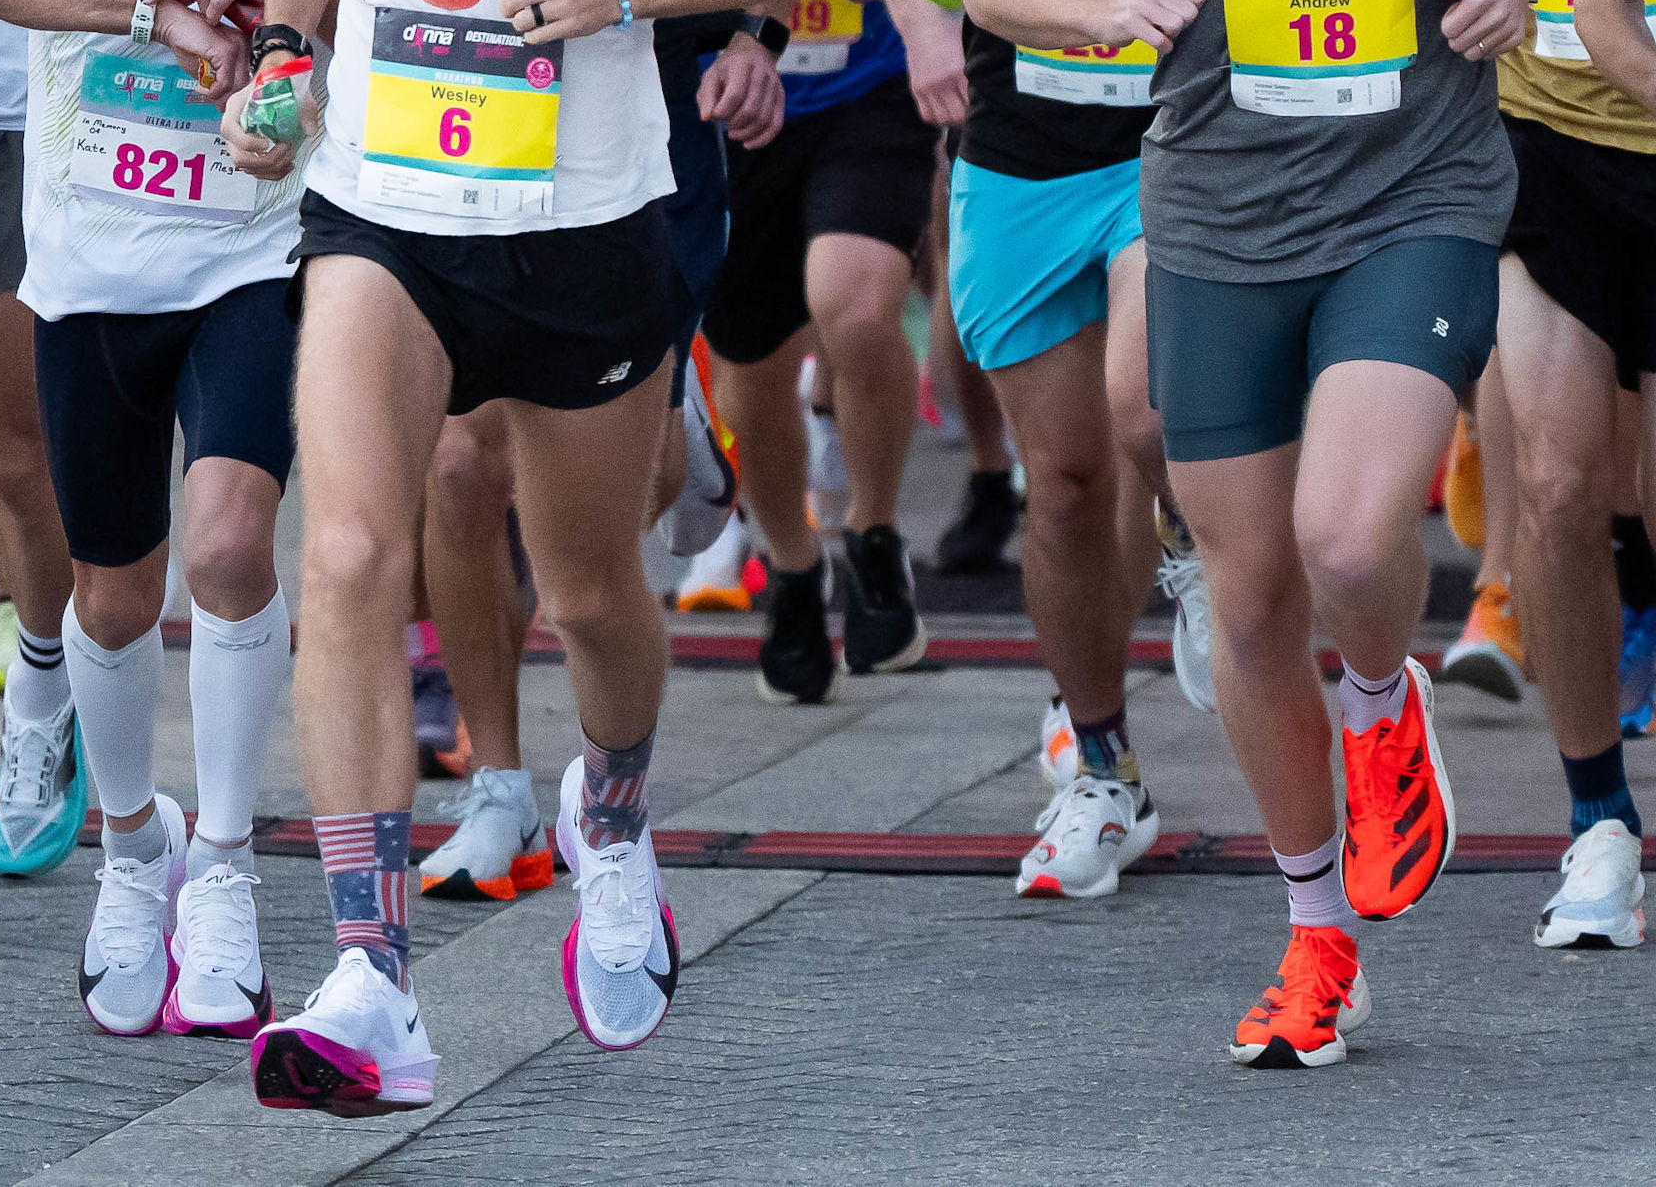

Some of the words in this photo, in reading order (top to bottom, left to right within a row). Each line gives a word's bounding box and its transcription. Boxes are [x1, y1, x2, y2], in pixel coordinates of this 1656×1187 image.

[1289, 12, 1357, 61] 18
[431, 86, 487, 107] Wesley
[93, 119, 127, 134] Memory
[145, 116, 172, 128] ULTRA
[439, 107, 472, 157] 6
[77, 138, 107, 155] Kate
[113, 142, 206, 201] 821
